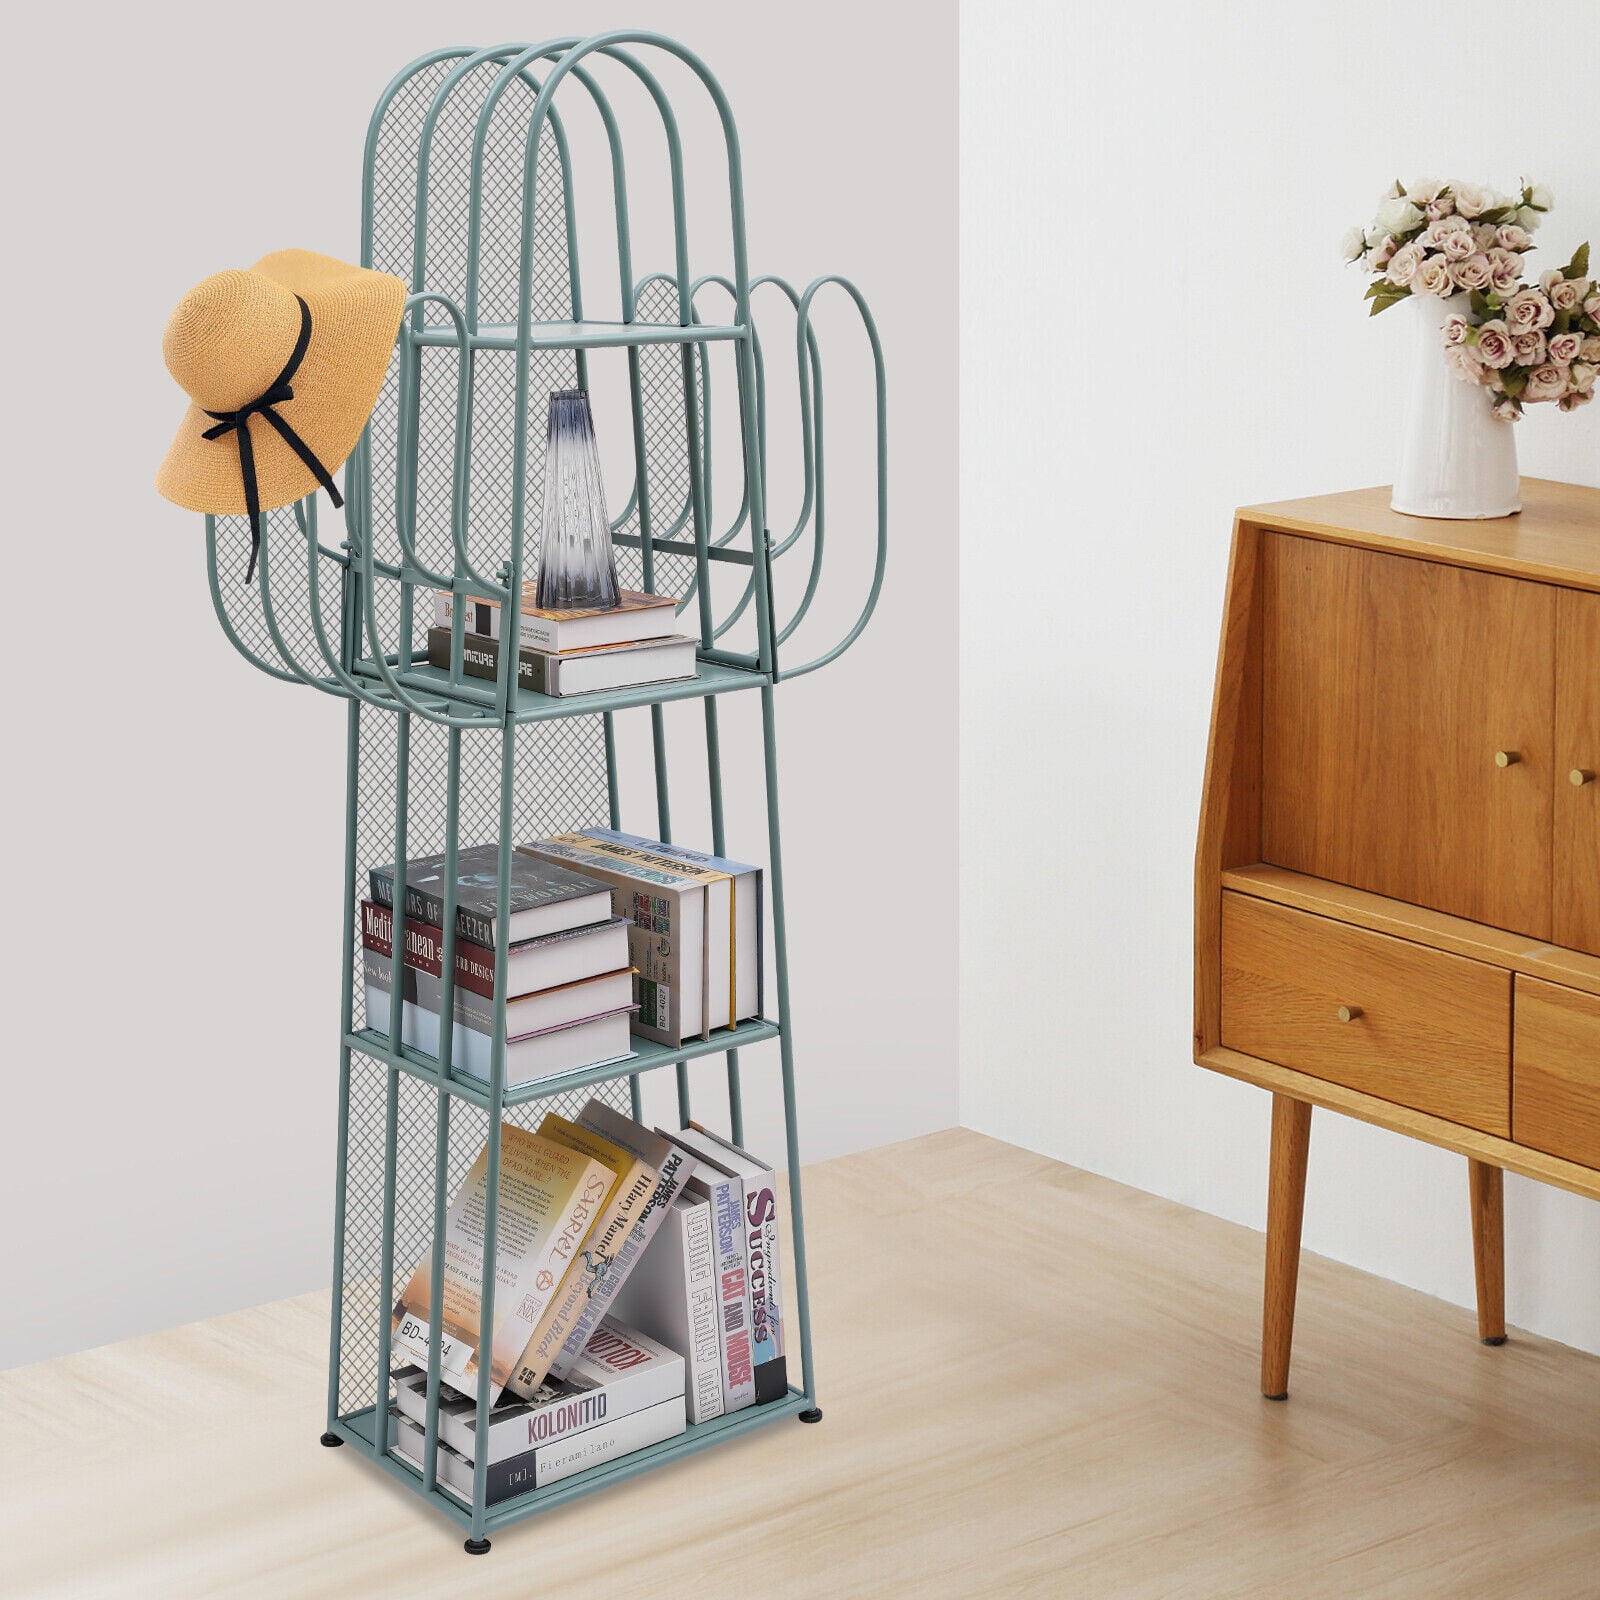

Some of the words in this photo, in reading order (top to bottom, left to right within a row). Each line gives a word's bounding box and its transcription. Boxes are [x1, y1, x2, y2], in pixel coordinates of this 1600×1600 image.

[426, 901, 440, 922] OF
[618, 1174, 652, 1215] Hilary
[657, 1178, 680, 1209] JAMES
[716, 1183, 734, 1255] PATTERSON
[729, 1199, 741, 1230] JAMES
[594, 1212, 629, 1261] Mantel
[721, 1267, 746, 1302] CAT
[764, 1223, 777, 1311] Ingredients
[558, 1272, 592, 1322] Beyond
[723, 1301, 744, 1333] AND
[766, 1314, 780, 1336] for
[401, 1321, 452, 1358] BD-44
[536, 1319, 565, 1358] Black
[725, 1329, 752, 1390] MOUSE
[528, 1392, 607, 1445] KOLONITID
[540, 1439, 615, 1473] Fieramilano
